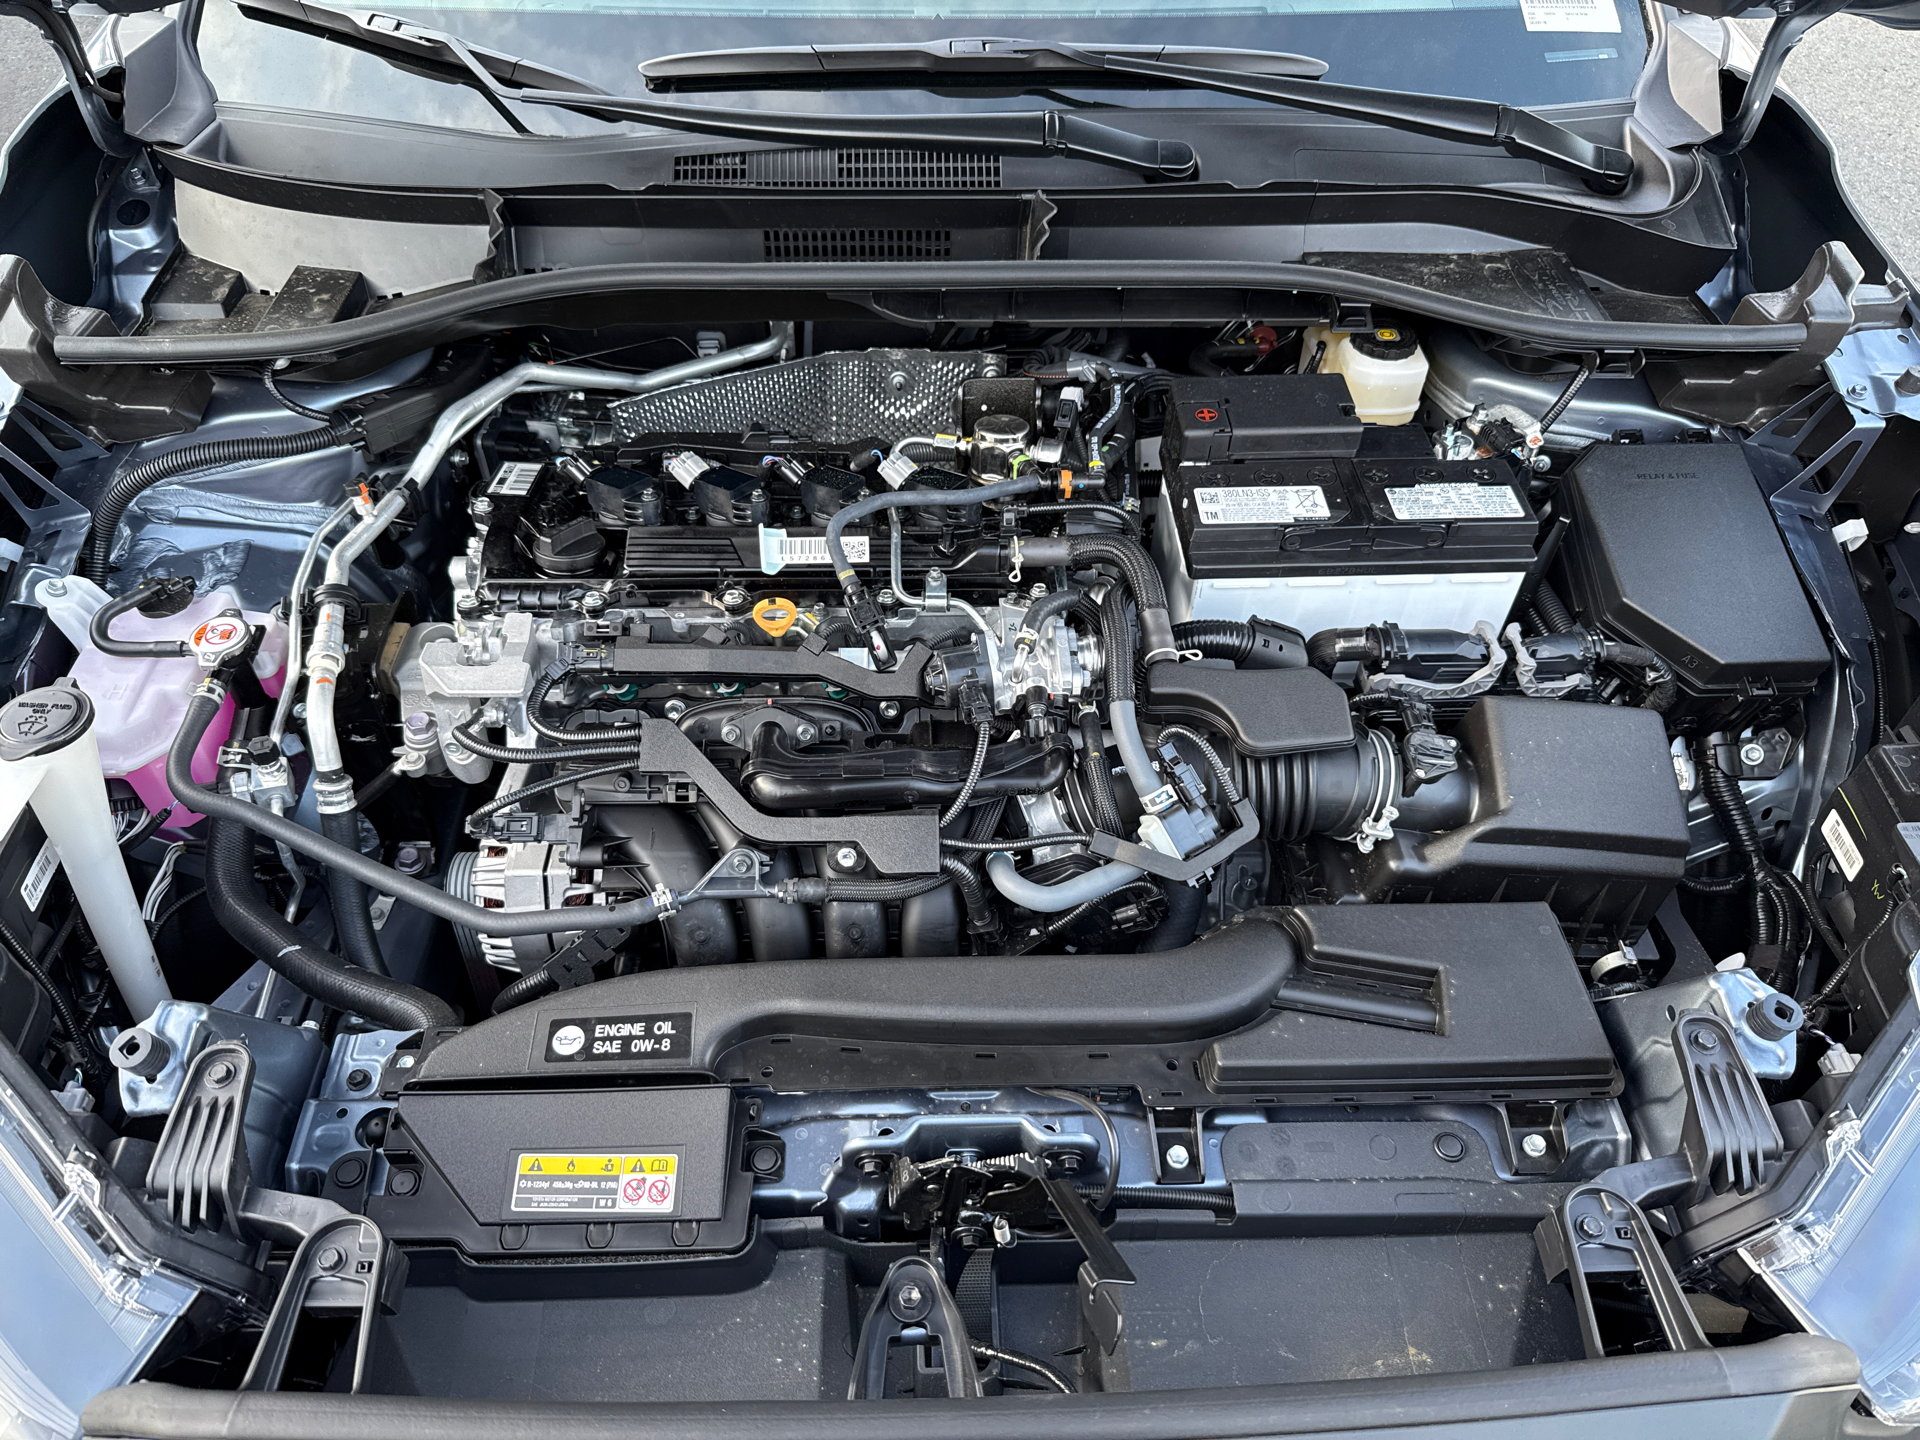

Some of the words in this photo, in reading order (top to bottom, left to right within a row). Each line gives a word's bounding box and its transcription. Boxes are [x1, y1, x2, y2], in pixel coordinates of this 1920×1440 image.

[1222, 489, 1271, 498] 380LN3-ISS
[1204, 511, 1219, 520] TM
[1681, 655, 1698, 669] A3
[595, 1022, 646, 1037] ENGINE
[653, 1021, 677, 1035] OIL
[592, 1040, 622, 1054] SAE
[630, 1038, 671, 1053] 0W-8
[599, 1199, 606, 1207] W
[607, 1199, 612, 1207] 6
